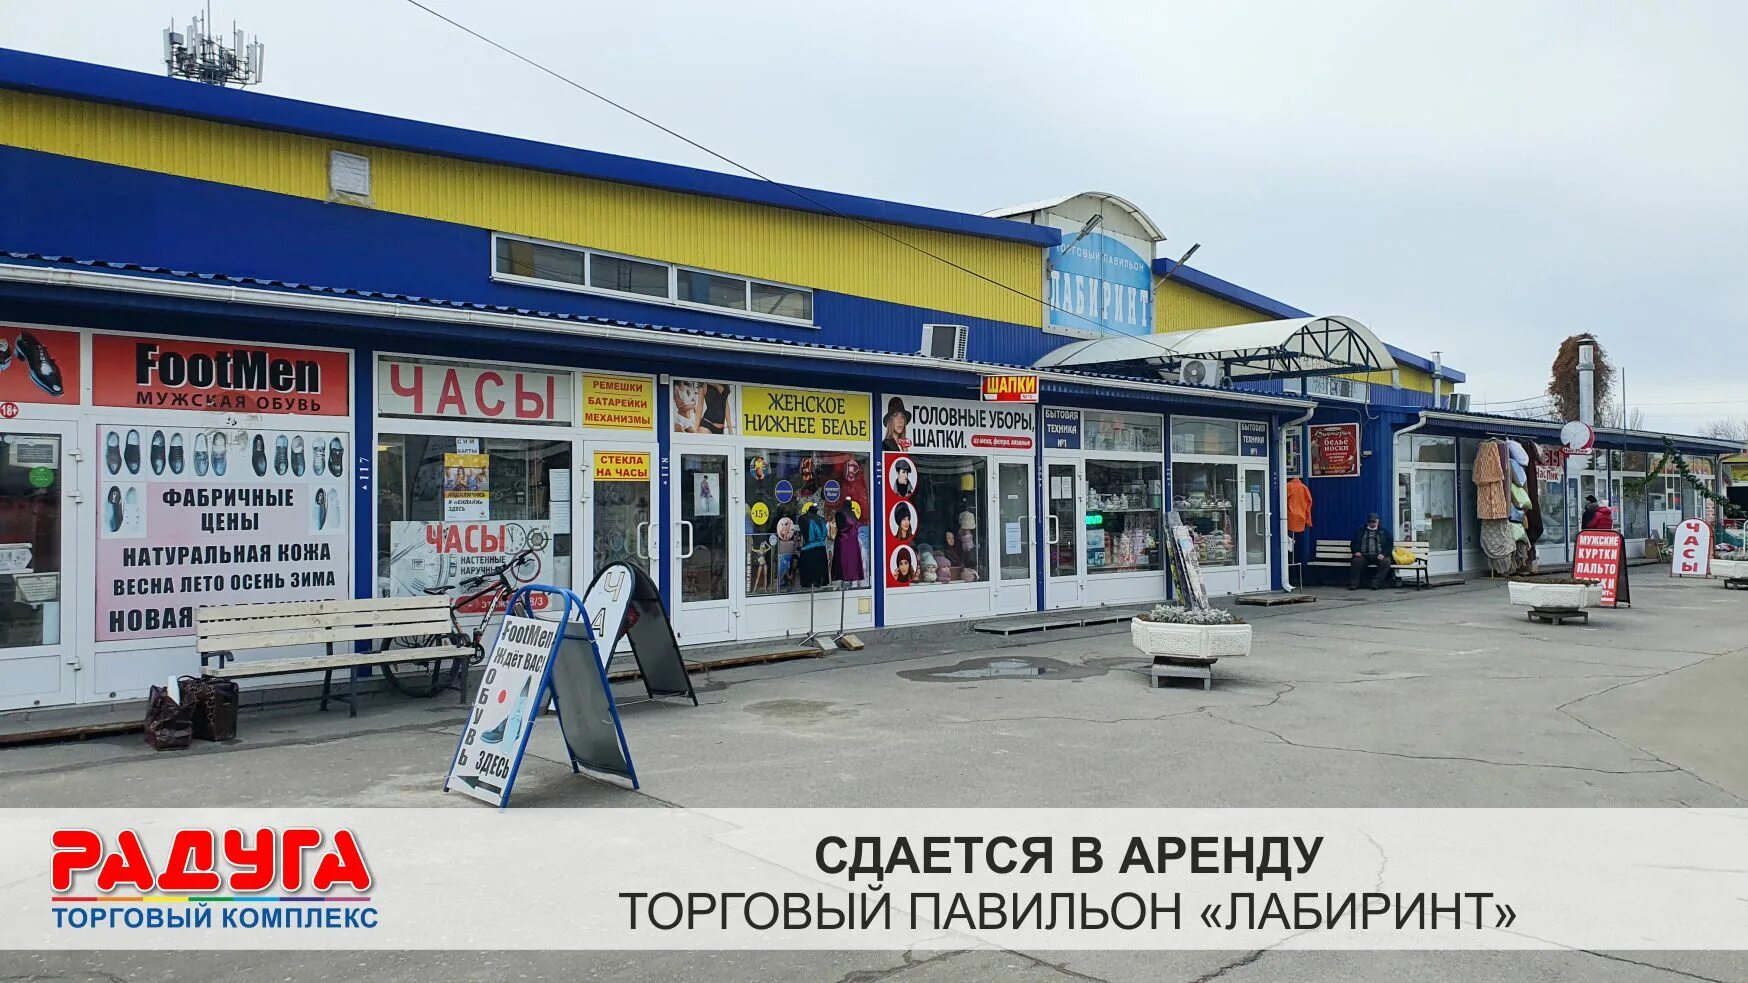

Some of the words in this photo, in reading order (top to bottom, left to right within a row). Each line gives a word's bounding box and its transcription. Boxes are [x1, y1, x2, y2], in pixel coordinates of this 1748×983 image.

[1103, 253, 1144, 272] ПАВИЛЬОН
[1050, 270, 1149, 328] ЛАБИРИНТ
[136, 343, 321, 394] FootMen
[390, 363, 555, 420] ЧАСЫ
[593, 380, 643, 393] РЕМЕШКИ
[986, 376, 1035, 394] ШАПКИ
[1, 404, 18, 416] 18+
[136, 391, 246, 409] МУЖСКАЯ
[256, 396, 321, 412] ОБУВЬ
[588, 396, 648, 409] БАТАРЕЙКИ
[767, 392, 846, 414] ЖЕНСКОЕ
[585, 412, 651, 425] МЕХАНИЗМЫ
[912, 405, 987, 428] ГОЛОВНЫЕ
[989, 410, 1035, 433] УБОРЫ,
[1045, 409, 1079, 420] БЫТОВАЯ
[744, 413, 816, 434] НИЖНЕЕ
[822, 416, 867, 437] БЕЛЬЕ
[1047, 423, 1077, 434] ТЕХНИКА
[1241, 423, 1266, 432] БЫТОВАЯ
[912, 428, 967, 449] ШАПКИ.
[1057, 438, 1067, 448] №1
[1242, 435, 1265, 444] ТЕХНИКА
[359, 456, 370, 481] 117
[600, 455, 644, 465] СТЕКЛА
[596, 468, 612, 477] НА
[615, 468, 648, 477] ЧАСЫ
[162, 488, 294, 507] ФАБРИЧНЫЕ
[200, 512, 259, 534] ЦЕНЫ
[426, 523, 506, 554] ЧАСЫ
[1579, 535, 1620, 547] МУЖСКИЕ
[1681, 522, 1700, 572] ЧАСЫ
[123, 544, 271, 567] НАТУРАЛЬНАЯ
[278, 543, 331, 562] КОЖА
[460, 555, 506, 565] НАСТЕННЫЕ
[1578, 548, 1618, 560] КУРТКИ
[460, 566, 503, 575] НАРУЧНЫ
[1576, 562, 1617, 575] ПАЛЬТО
[113, 577, 175, 597] ВЕСНА
[180, 575, 225, 594] ЛЕТО
[230, 573, 285, 591] ОСЕНЬ
[290, 571, 336, 588] ЗИМА
[110, 606, 193, 633] НОВАЯ
[502, 620, 554, 650] FootMen
[493, 646, 523, 669] Ждёт
[523, 652, 547, 674] ВАС!
[457, 668, 498, 766] ОБУВЬ
[475, 749, 510, 780] ЗДЕСЬ
